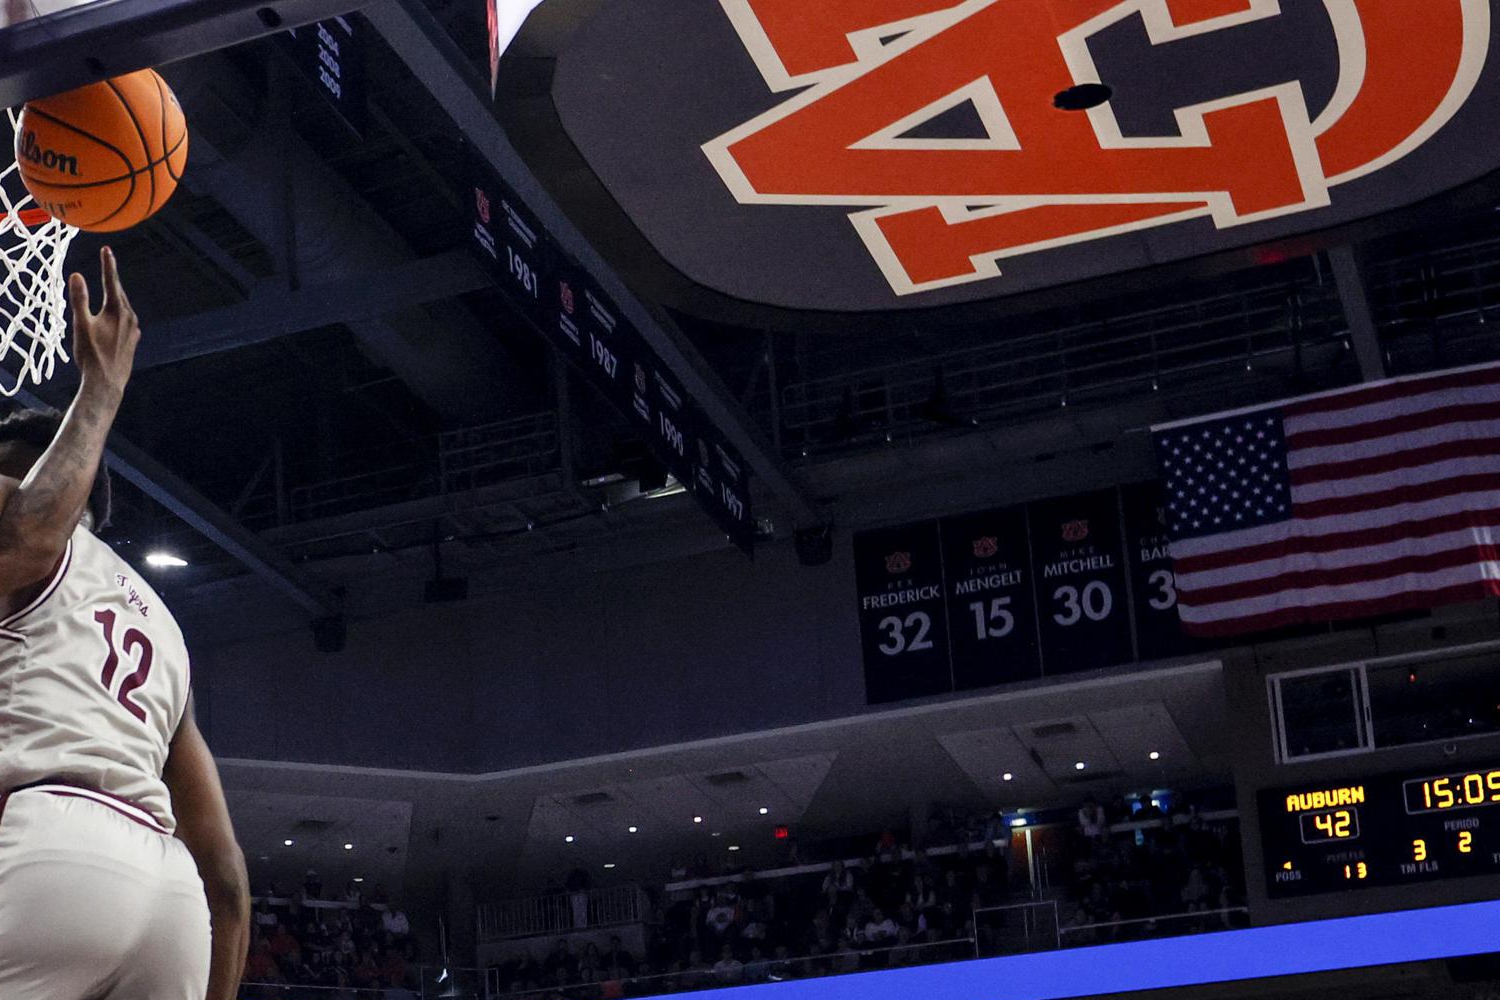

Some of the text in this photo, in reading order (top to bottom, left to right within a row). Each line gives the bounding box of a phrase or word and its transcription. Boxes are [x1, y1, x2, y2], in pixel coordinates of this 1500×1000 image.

[18, 127, 78, 177] ilson
[507, 245, 538, 299] 1981
[590, 331, 617, 378] 1987
[659, 411, 683, 456] 1990
[955, 569, 1023, 595] MENGELT
[1043, 553, 1115, 578] MITCHELL
[862, 585, 941, 610] FREDERICK
[1053, 580, 1113, 627] 30
[1148, 569, 1177, 610] 3
[878, 611, 934, 656] 32
[969, 597, 1015, 640] 15
[93, 608, 153, 725] 12
[1286, 785, 1365, 813] AUBURN
[1315, 810, 1351, 838] 42
[1444, 817, 1480, 831] PERIOD
[1458, 831, 1473, 853] 2
[1413, 838, 1428, 862] 3
